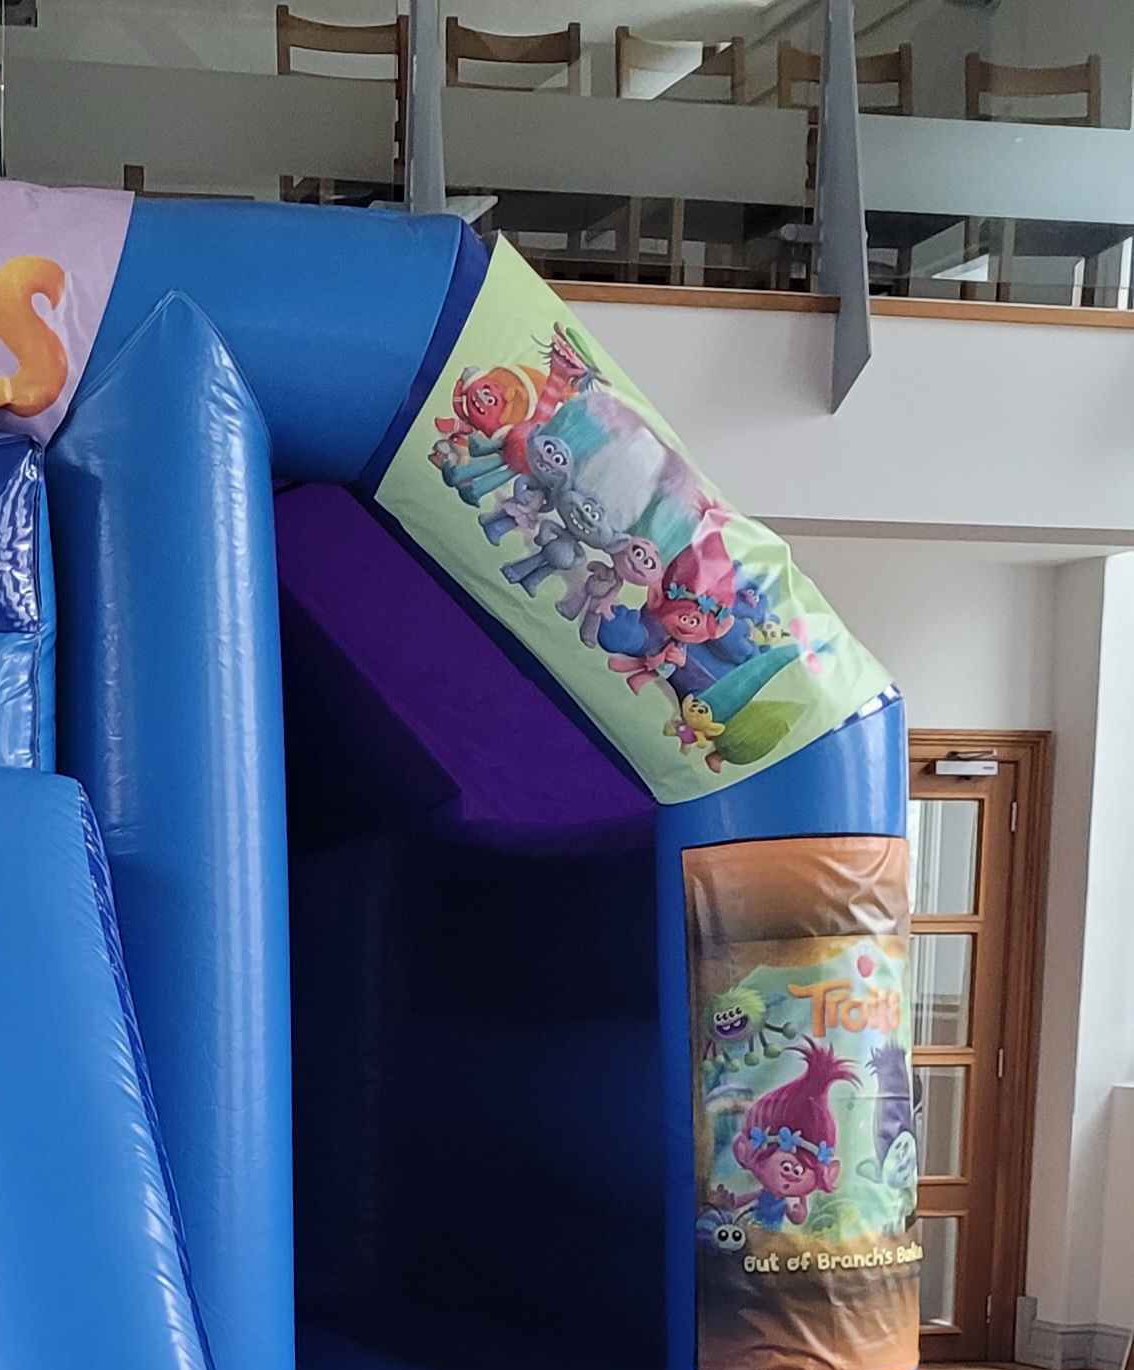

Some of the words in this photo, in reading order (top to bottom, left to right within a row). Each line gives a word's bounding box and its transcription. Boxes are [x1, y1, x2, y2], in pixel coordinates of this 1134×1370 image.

[787, 978, 901, 1038] Trolls
[743, 1253, 780, 1272] Out
[787, 1252, 812, 1271] of
[817, 1247, 894, 1270] Branch's
